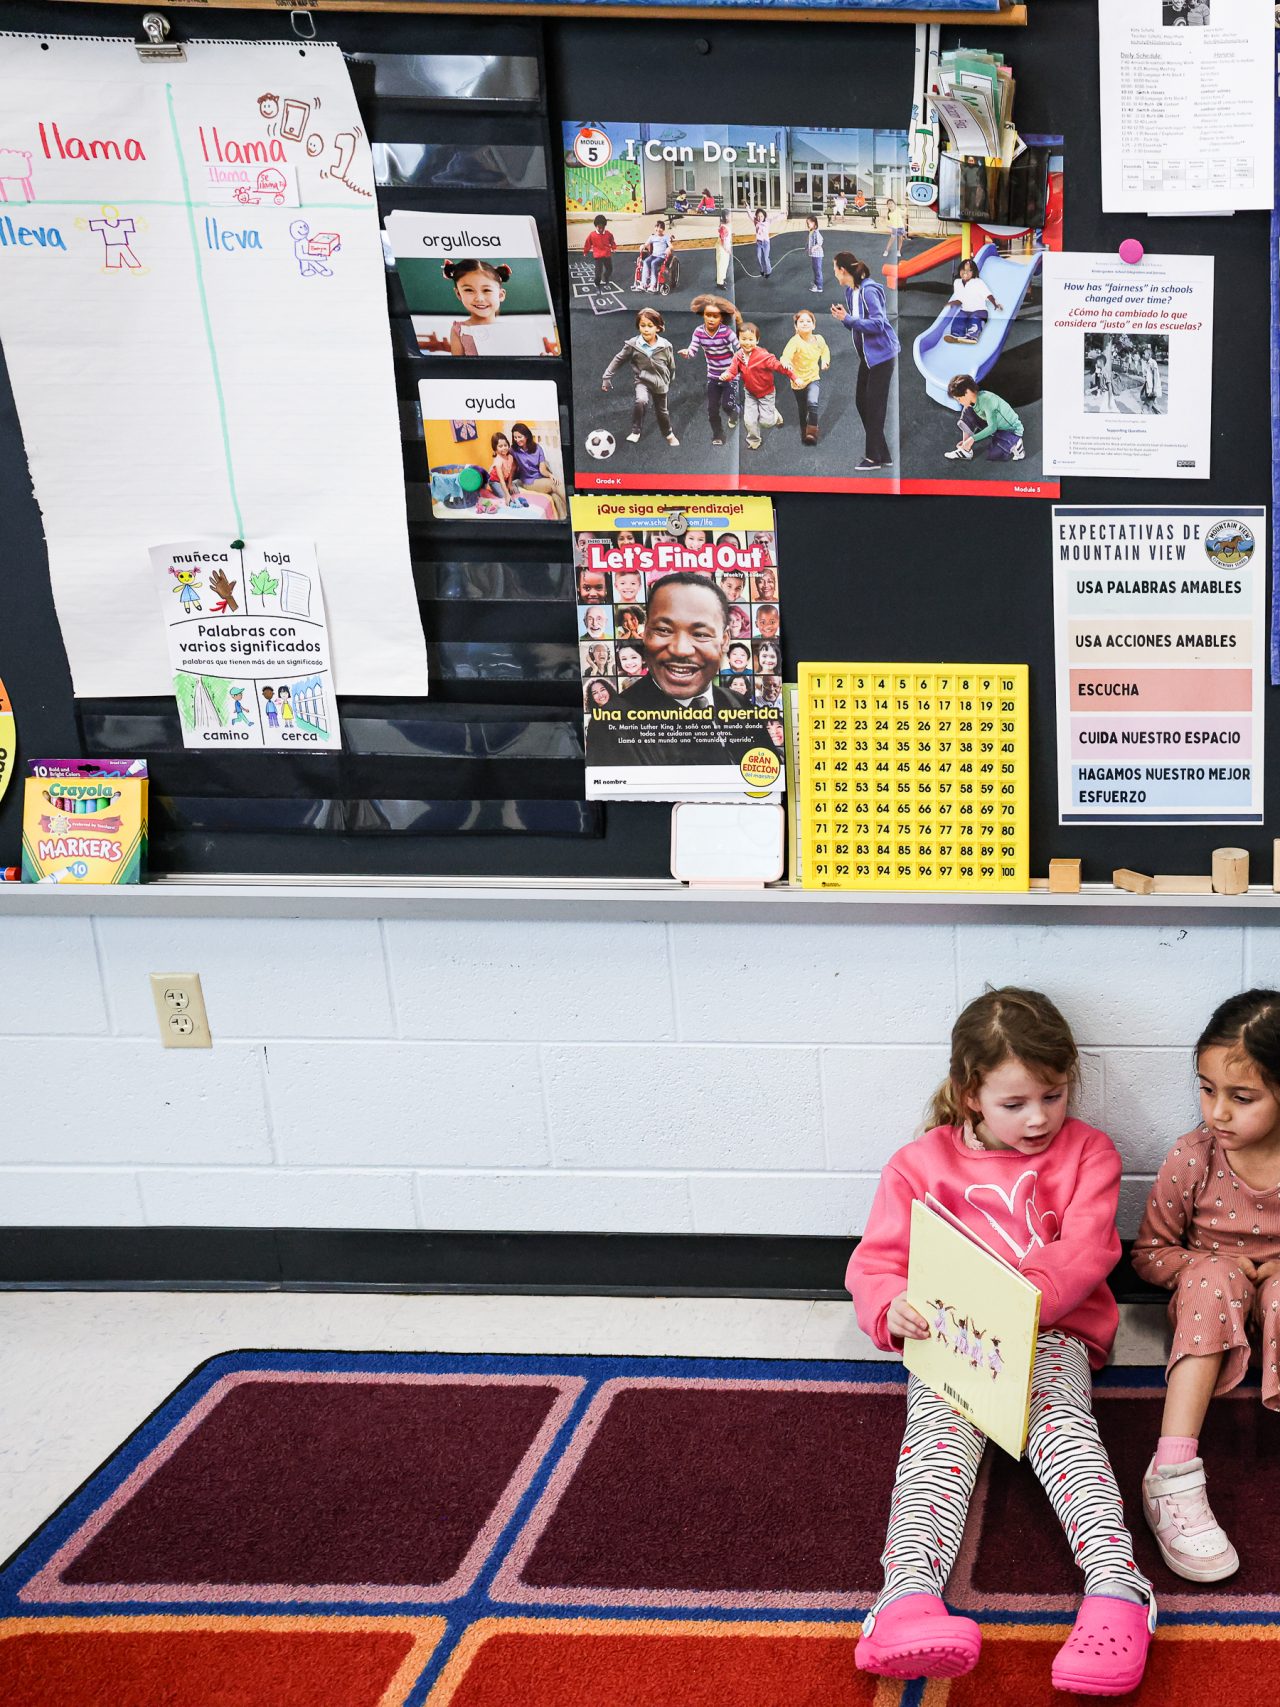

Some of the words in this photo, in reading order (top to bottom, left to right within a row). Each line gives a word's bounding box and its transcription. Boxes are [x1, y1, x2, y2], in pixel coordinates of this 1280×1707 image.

[38, 121, 146, 161] llama
[199, 126, 287, 163] llama
[588, 148, 598, 162] 5
[625, 140, 636, 161] I
[645, 140, 694, 162] Can
[703, 141, 737, 162] Do
[746, 142, 777, 164] It!
[205, 216, 263, 251] lleva
[422, 231, 501, 250] orgullosa
[1064, 282, 1085, 290] How
[1086, 283, 1102, 291] has
[1150, 285, 1159, 293] in
[1160, 285, 1193, 293] schools
[1085, 294, 1123, 305] changed
[1147, 296, 1172, 304] time?
[1069, 308, 1099, 318] ¿Cómo
[1101, 308, 1113, 317] ha
[1115, 309, 1158, 318] cambiado
[1160, 309, 1169, 318] lo
[1171, 312, 1188, 320] que
[1054, 320, 1097, 328] considera
[1145, 321, 1158, 329] las
[1159, 322, 1203, 331] escuelas?
[465, 395, 516, 412] ayuda
[1060, 524, 1176, 540] EXPECTATIVAS
[1183, 524, 1200, 540] DE
[173, 552, 229, 563] muñeca
[264, 552, 291, 565] hoja
[658, 546, 714, 568] Find
[717, 546, 762, 568] Out
[1060, 545, 1140, 561] MOUNTAIN
[1149, 545, 1187, 561] VIEW
[1076, 581, 1103, 594] USA
[1107, 581, 1177, 594] PALABRAS
[1180, 581, 1242, 594] AMABLES
[198, 625, 265, 637] Palabras
[270, 626, 296, 636] con
[180, 641, 226, 652] varios
[230, 640, 320, 655] significados
[1075, 635, 1102, 648] USA
[1106, 635, 1172, 648] ACCIONES
[1176, 635, 1237, 648] AMABLES
[1078, 683, 1140, 696] ESCUCHA
[593, 708, 622, 721] Una
[627, 708, 713, 720] comunidad
[718, 707, 778, 722] querida
[203, 730, 249, 741] camino
[282, 732, 318, 741] cerca
[1078, 731, 1118, 745] CUIDA
[1121, 731, 1181, 745] NUESTRO
[1184, 731, 1241, 745] ESPACIO
[1078, 768, 1142, 781] HAGAMOS
[1145, 768, 1205, 781] NUESTRO
[1208, 768, 1251, 781] MEJOR
[49, 783, 113, 799] Crayola
[1079, 790, 1147, 803] ESFUERZO
[39, 838, 122, 861] MARKERS
[816, 865, 828, 875] 91
[836, 865, 849, 875] 92
[856, 865, 870, 875] 93
[877, 865, 890, 875] 94
[898, 866, 911, 876] 95
